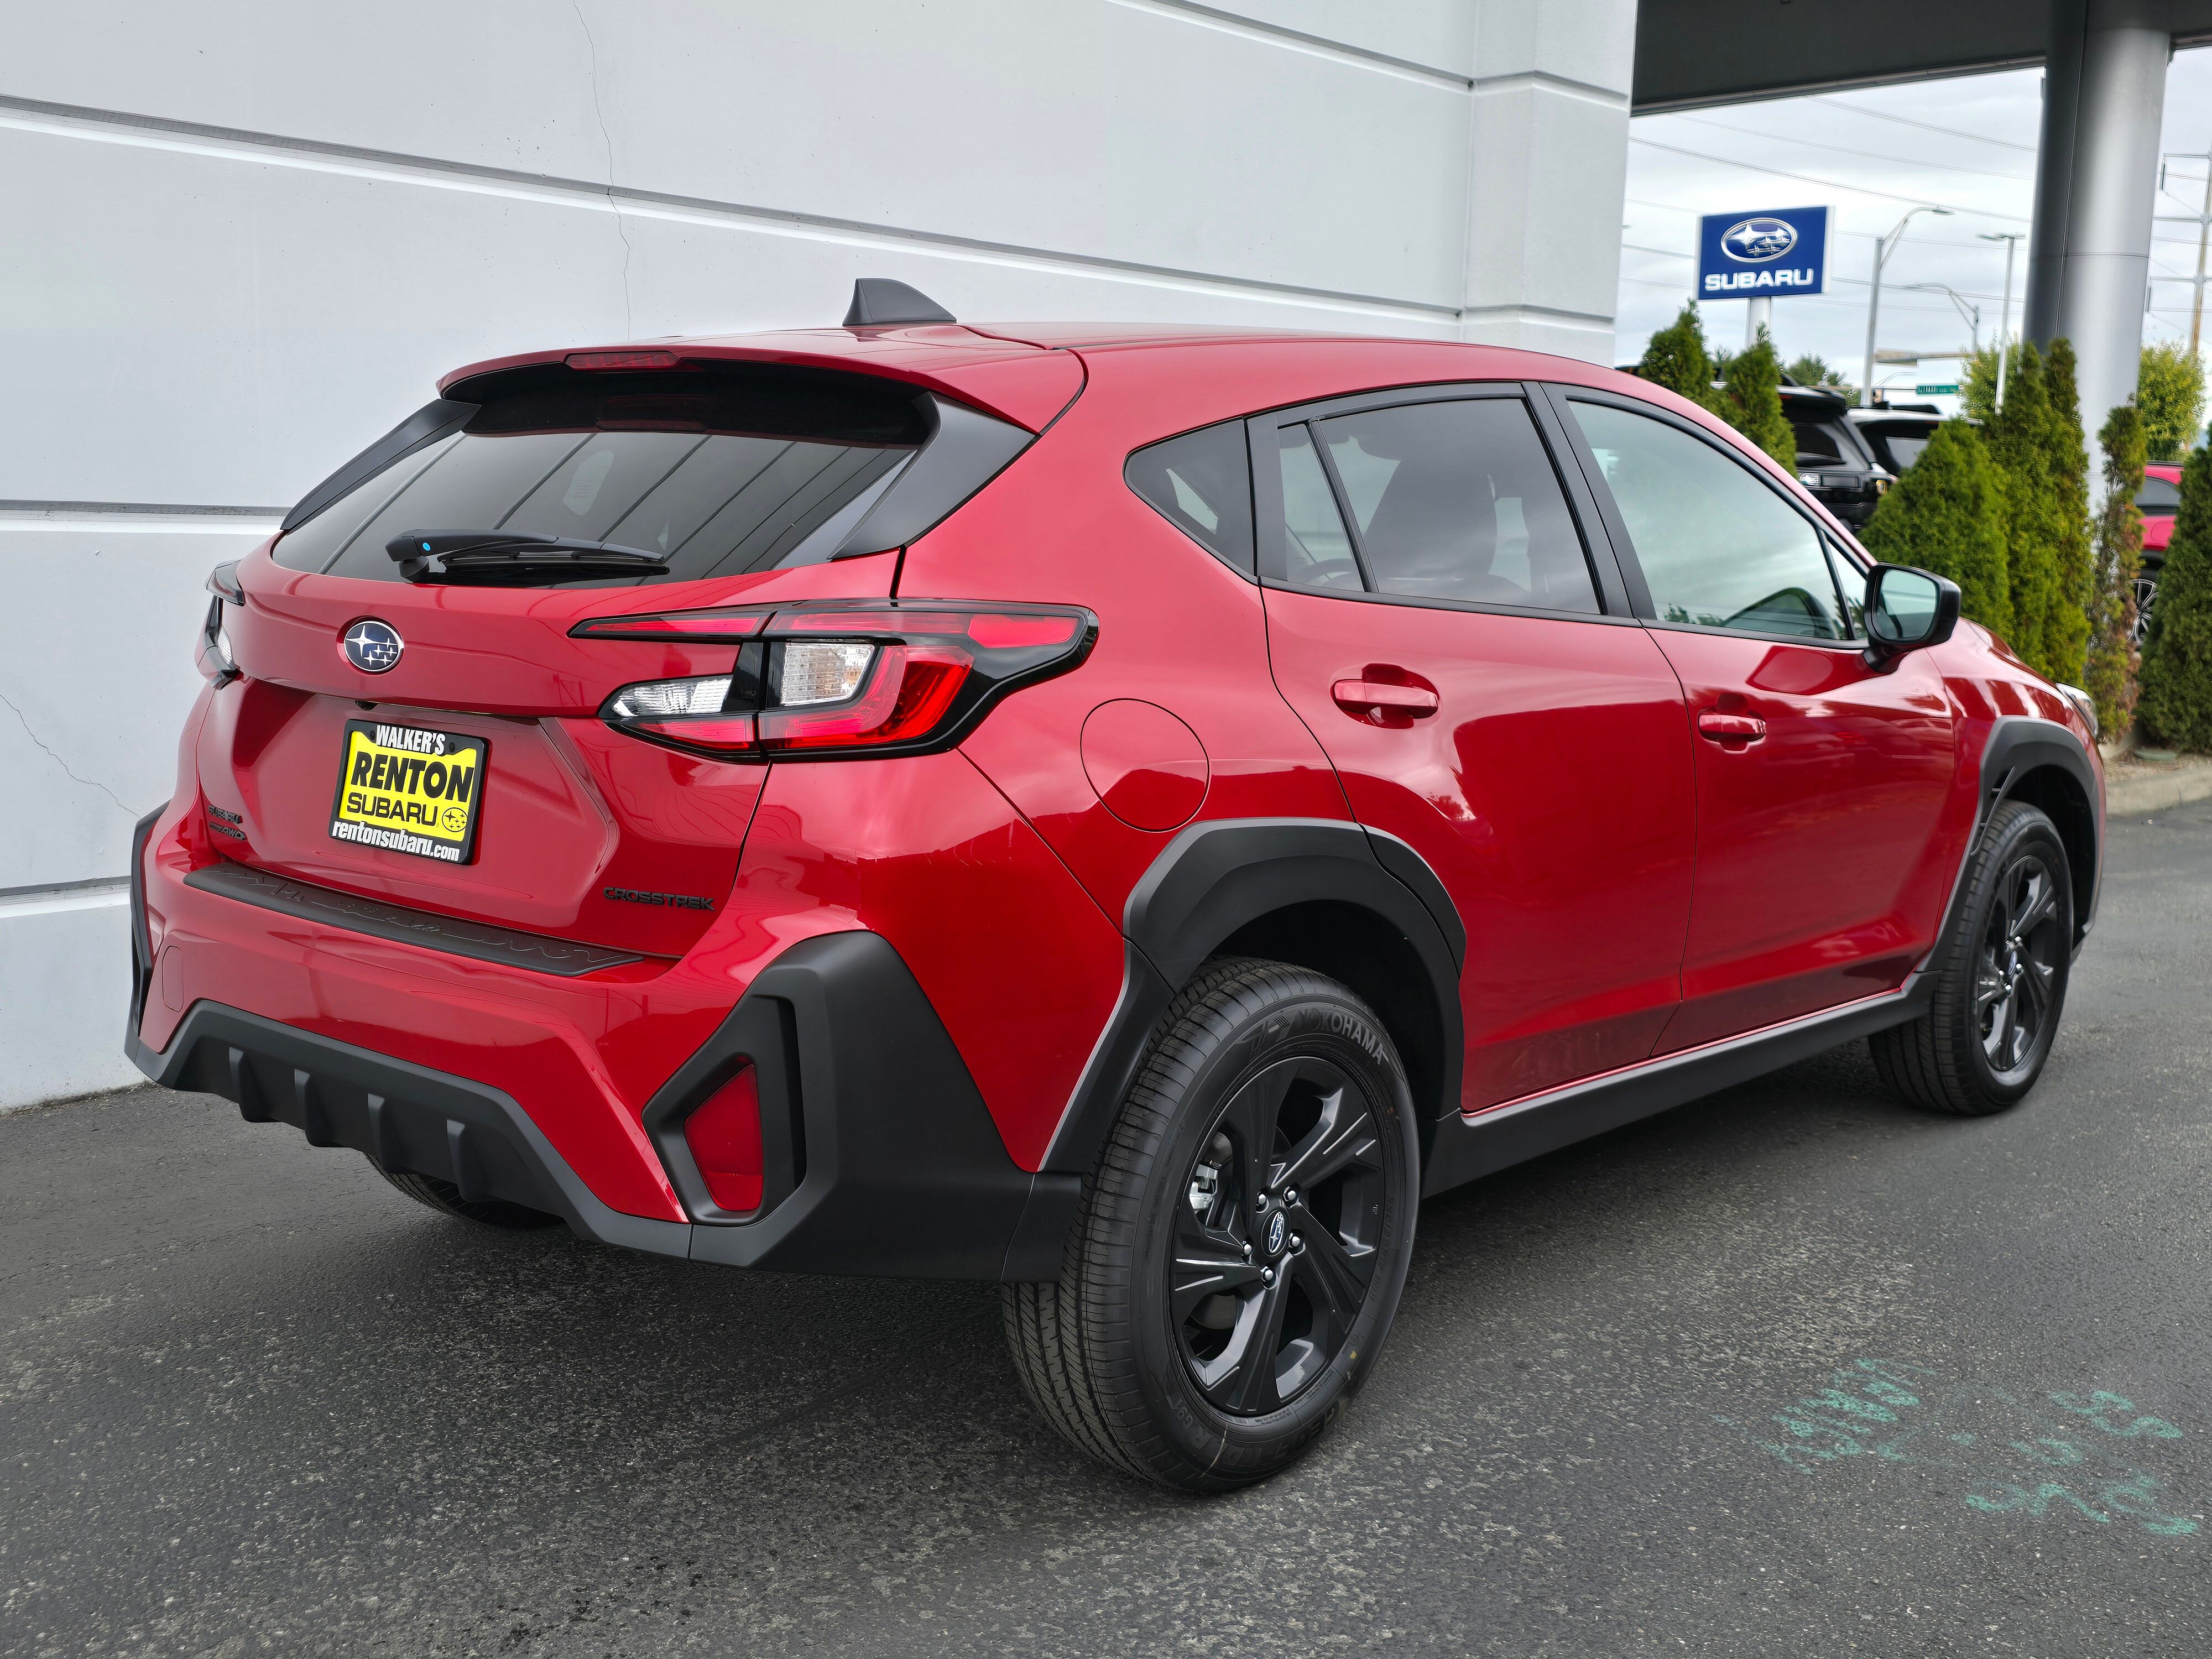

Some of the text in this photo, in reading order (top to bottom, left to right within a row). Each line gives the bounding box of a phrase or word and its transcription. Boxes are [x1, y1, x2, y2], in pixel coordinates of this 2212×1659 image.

[1704, 268, 1814, 291] SUBARU
[375, 724, 446, 756] WALKER'S
[350, 751, 474, 803] RENTON
[346, 792, 439, 826] SUBARU
[332, 820, 460, 862] rentonsubaru.com
[603, 886, 715, 911] CROSSTREK
[1297, 1008, 1384, 1066] YOKOHAMA
